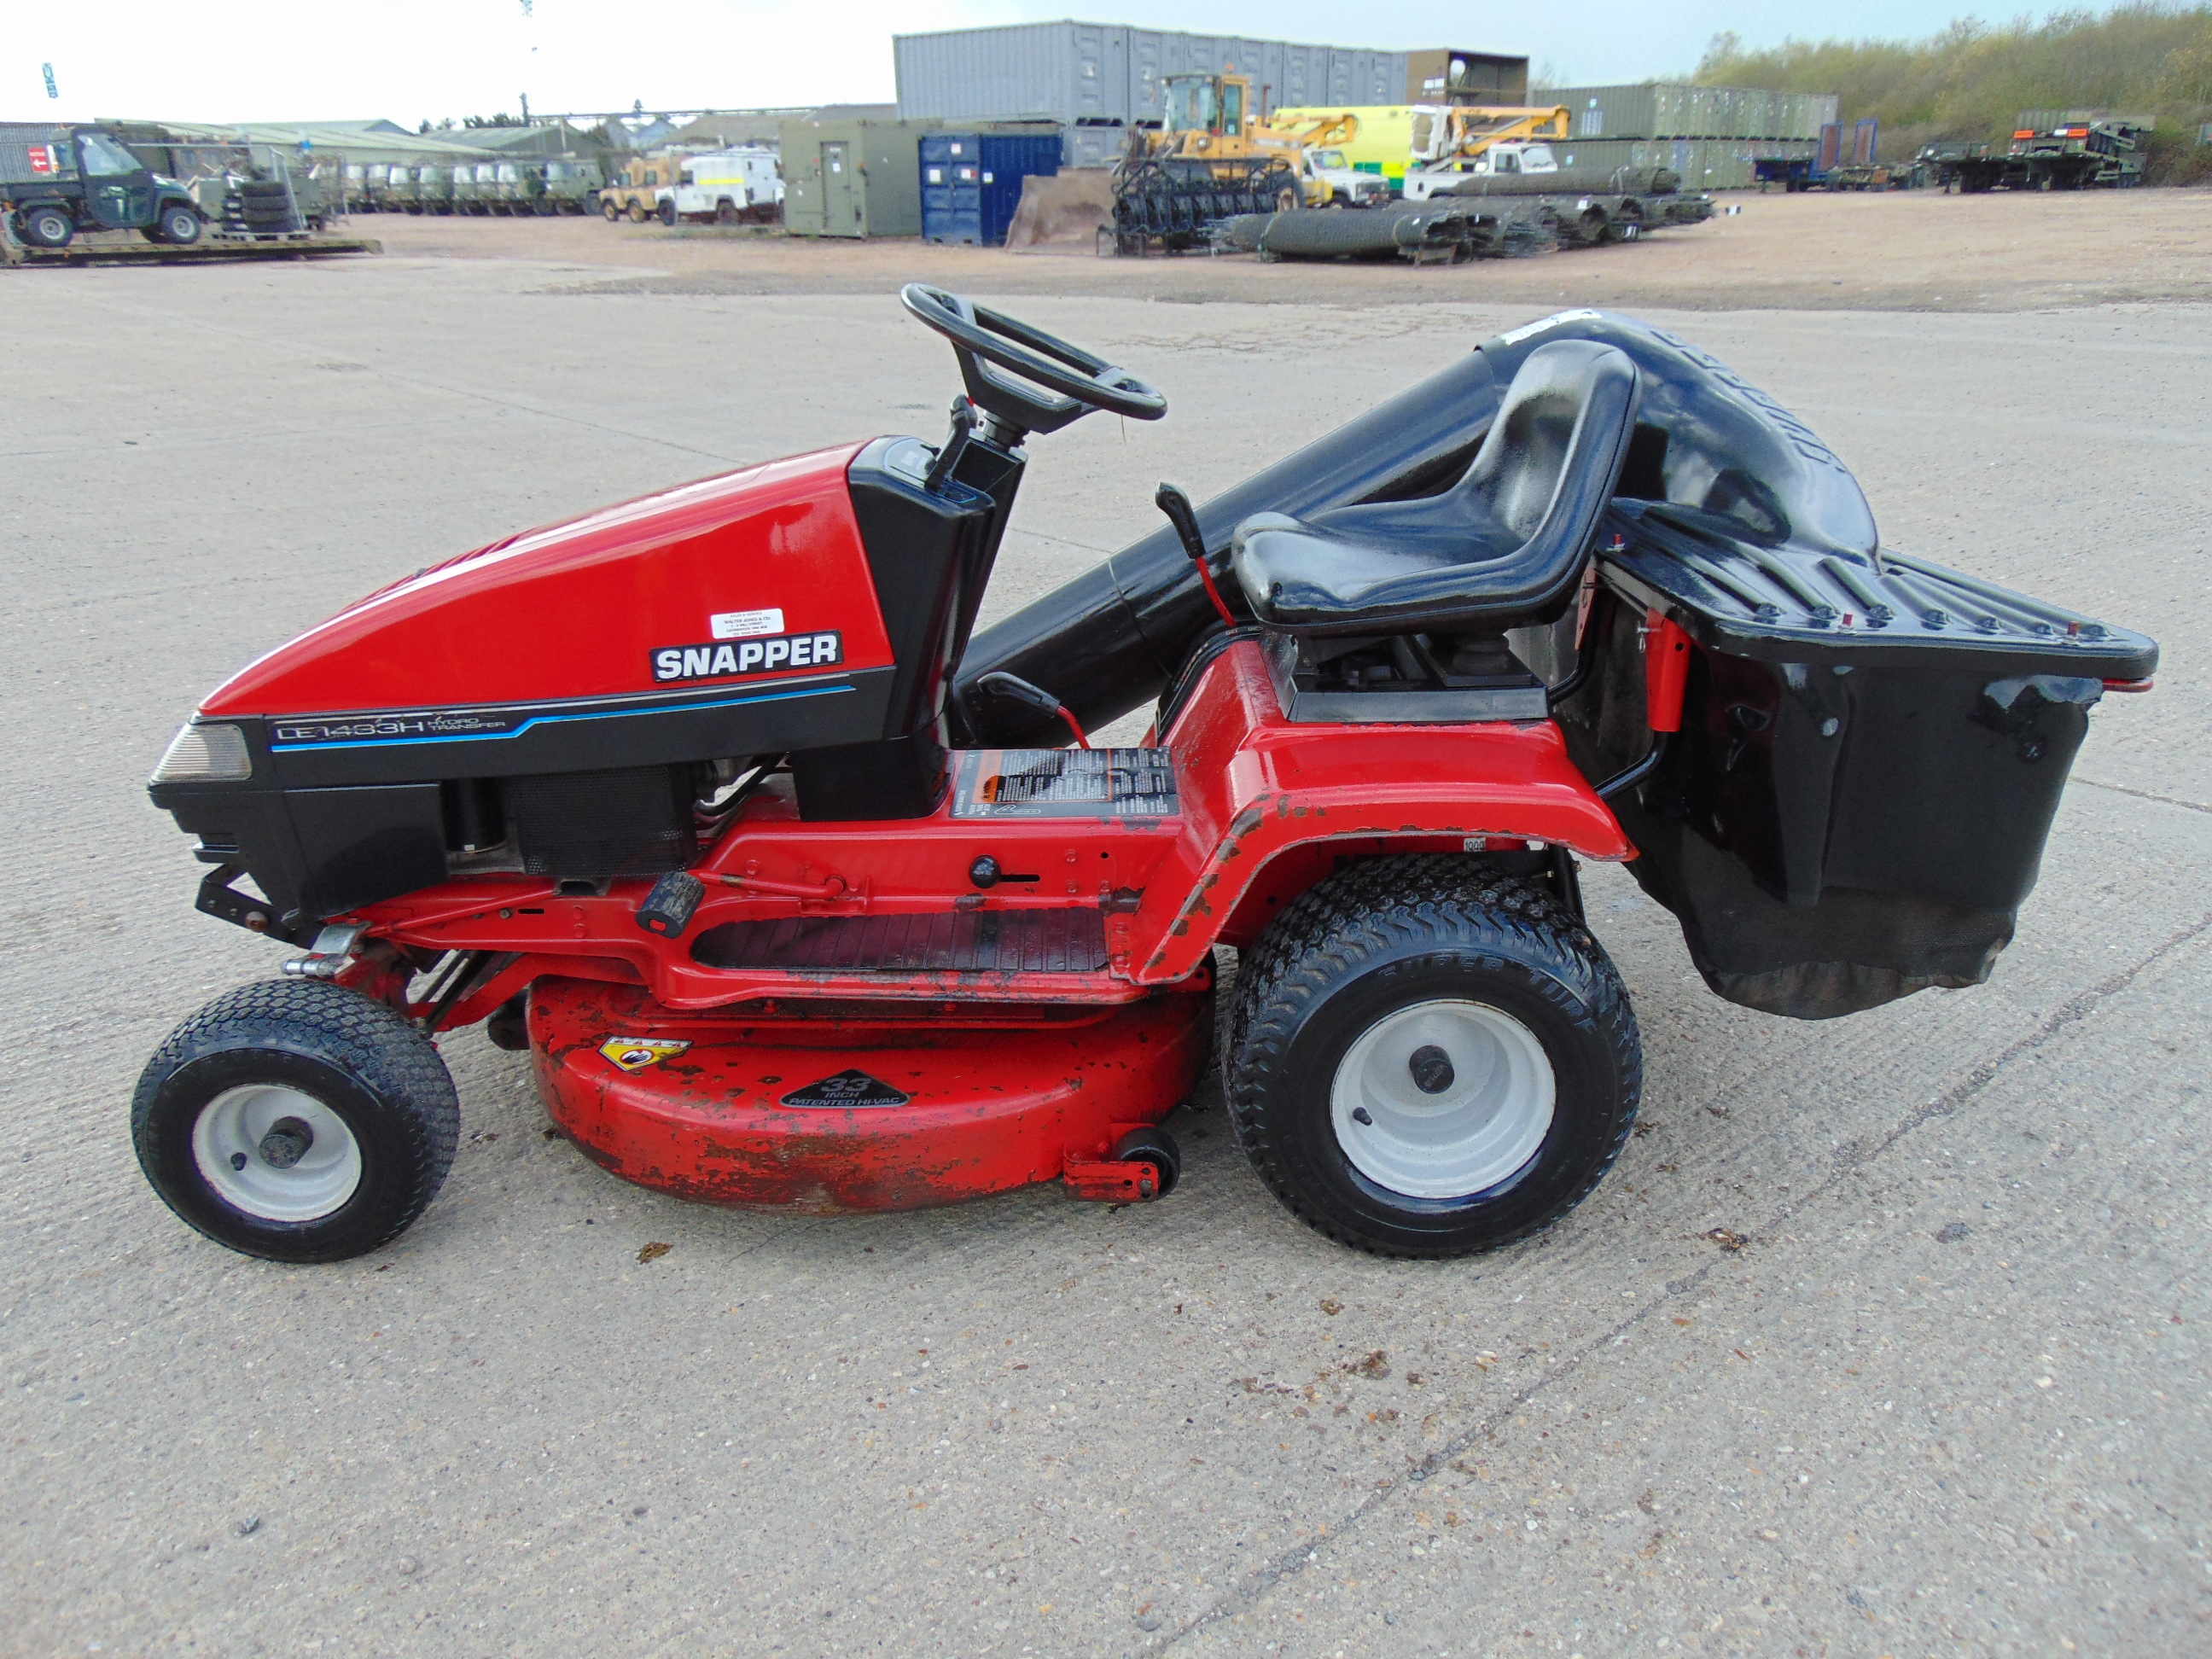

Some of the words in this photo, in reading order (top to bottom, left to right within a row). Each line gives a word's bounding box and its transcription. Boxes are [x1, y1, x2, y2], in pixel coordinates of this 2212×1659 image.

[657, 635, 837, 679] SNAPPER
[428, 718, 480, 726] HYDRO
[430, 722, 506, 731] TRANSFER
[1528, 968, 1598, 1034] TURF
[821, 1078, 871, 1092] 33
[789, 1097, 854, 1106] PATENTED
[858, 1097, 900, 1106] HI-VAC
